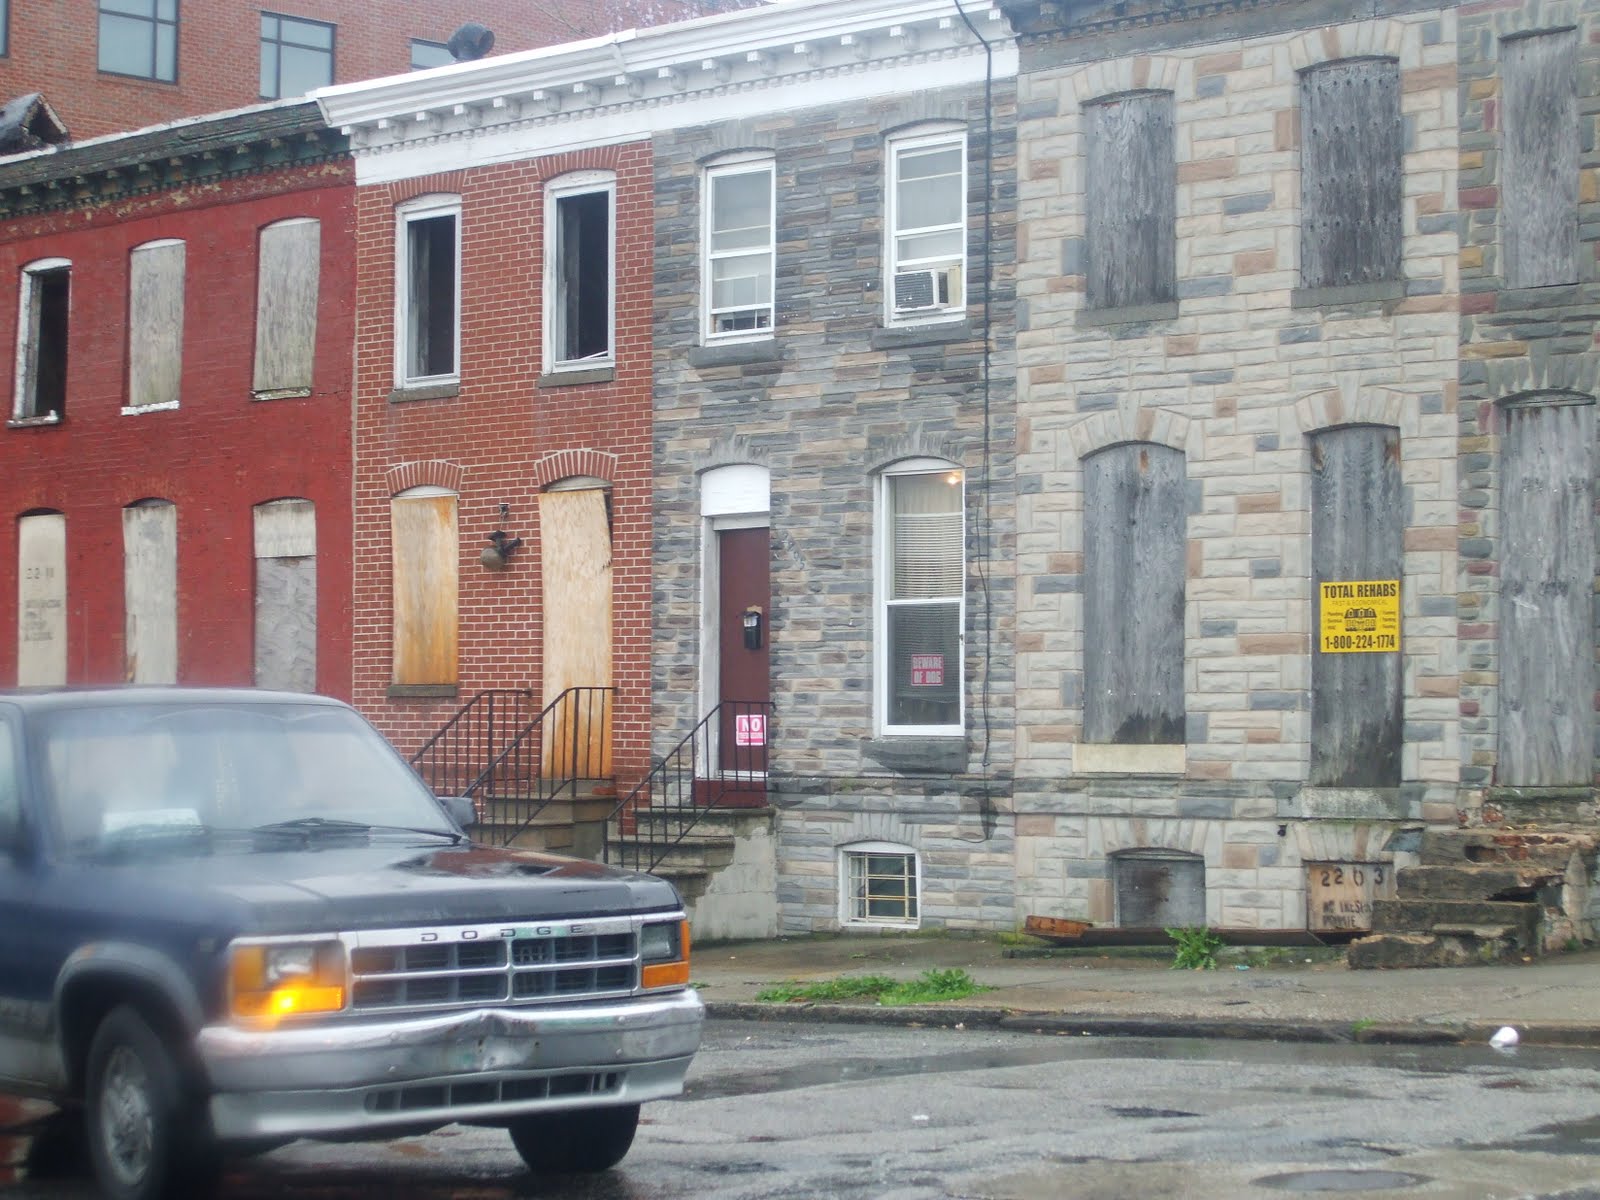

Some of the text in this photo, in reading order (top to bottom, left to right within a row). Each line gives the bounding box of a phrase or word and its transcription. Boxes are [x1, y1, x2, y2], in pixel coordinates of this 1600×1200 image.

[1324, 583, 1396, 598] TOTAL REHABS
[1325, 634, 1395, 649] 1-800-224-1774
[913, 656, 942, 669] BEWARE
[914, 671, 941, 683] OF DOG
[741, 718, 761, 732] NO
[420, 924, 584, 942] DODGE
